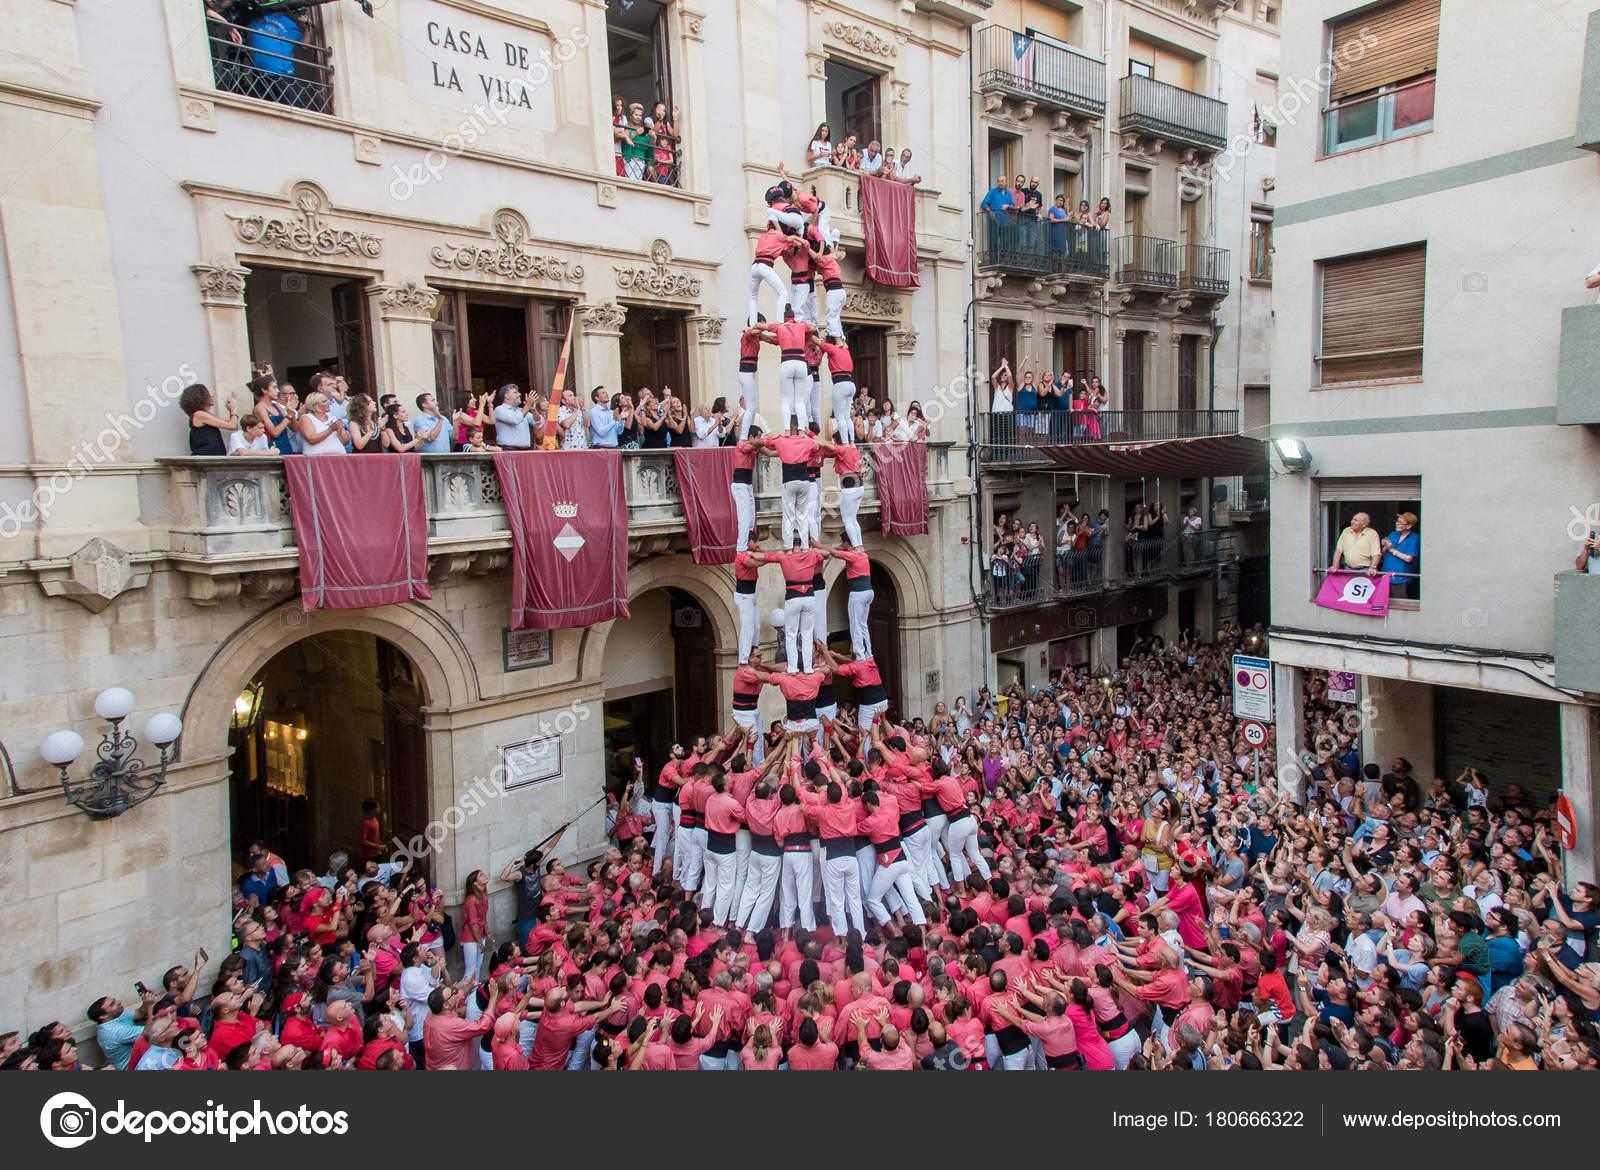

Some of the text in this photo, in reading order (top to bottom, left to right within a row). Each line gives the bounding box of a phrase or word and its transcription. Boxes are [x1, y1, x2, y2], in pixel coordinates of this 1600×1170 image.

[427, 22, 529, 70] CASA DE
[432, 61, 533, 109] LA VILA
[1247, 729, 1261, 739] 20
